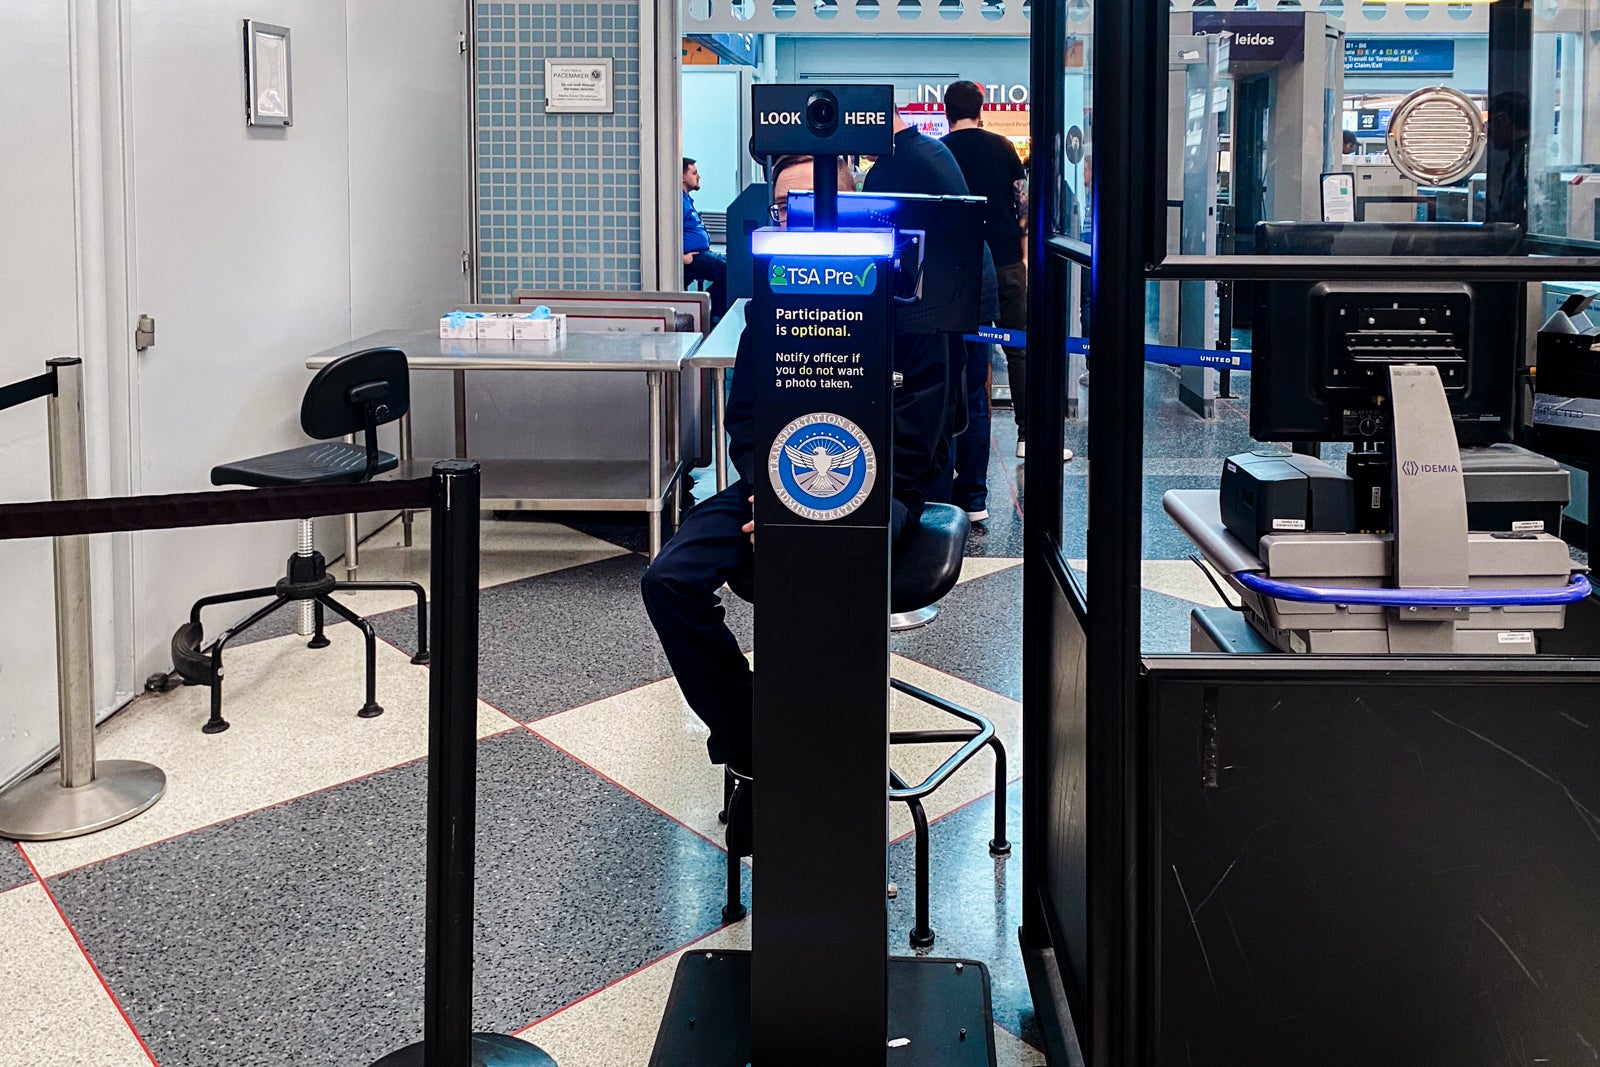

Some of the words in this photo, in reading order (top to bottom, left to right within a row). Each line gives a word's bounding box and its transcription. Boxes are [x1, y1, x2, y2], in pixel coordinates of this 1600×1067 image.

[1235, 33, 1274, 45] leidos
[917, 83, 1028, 104] INTIO
[760, 112, 802, 125] LOOK
[845, 112, 886, 125] HERE
[787, 268, 821, 285] TSA
[825, 268, 853, 285] Pre
[775, 308, 863, 322] Participation
[775, 324, 787, 336] is
[791, 324, 851, 338] optional.
[978, 332, 1003, 340] UNITED
[775, 352, 810, 364] Notify
[813, 352, 849, 363] officer
[852, 353, 861, 363] if
[1200, 355, 1231, 364] UNITED
[775, 366, 796, 376] you
[799, 365, 813, 375] do
[816, 366, 834, 375] not
[837, 366, 864, 376] want
[775, 379, 782, 387] a
[785, 378, 817, 389] photo
[820, 379, 853, 388] taken.
[770, 414, 845, 473] TRANSPORTATION
[846, 423, 875, 474] SECURITY
[1421, 464, 1458, 473] IDEMIA
[775, 488, 868, 519] ADMINISTRATION
